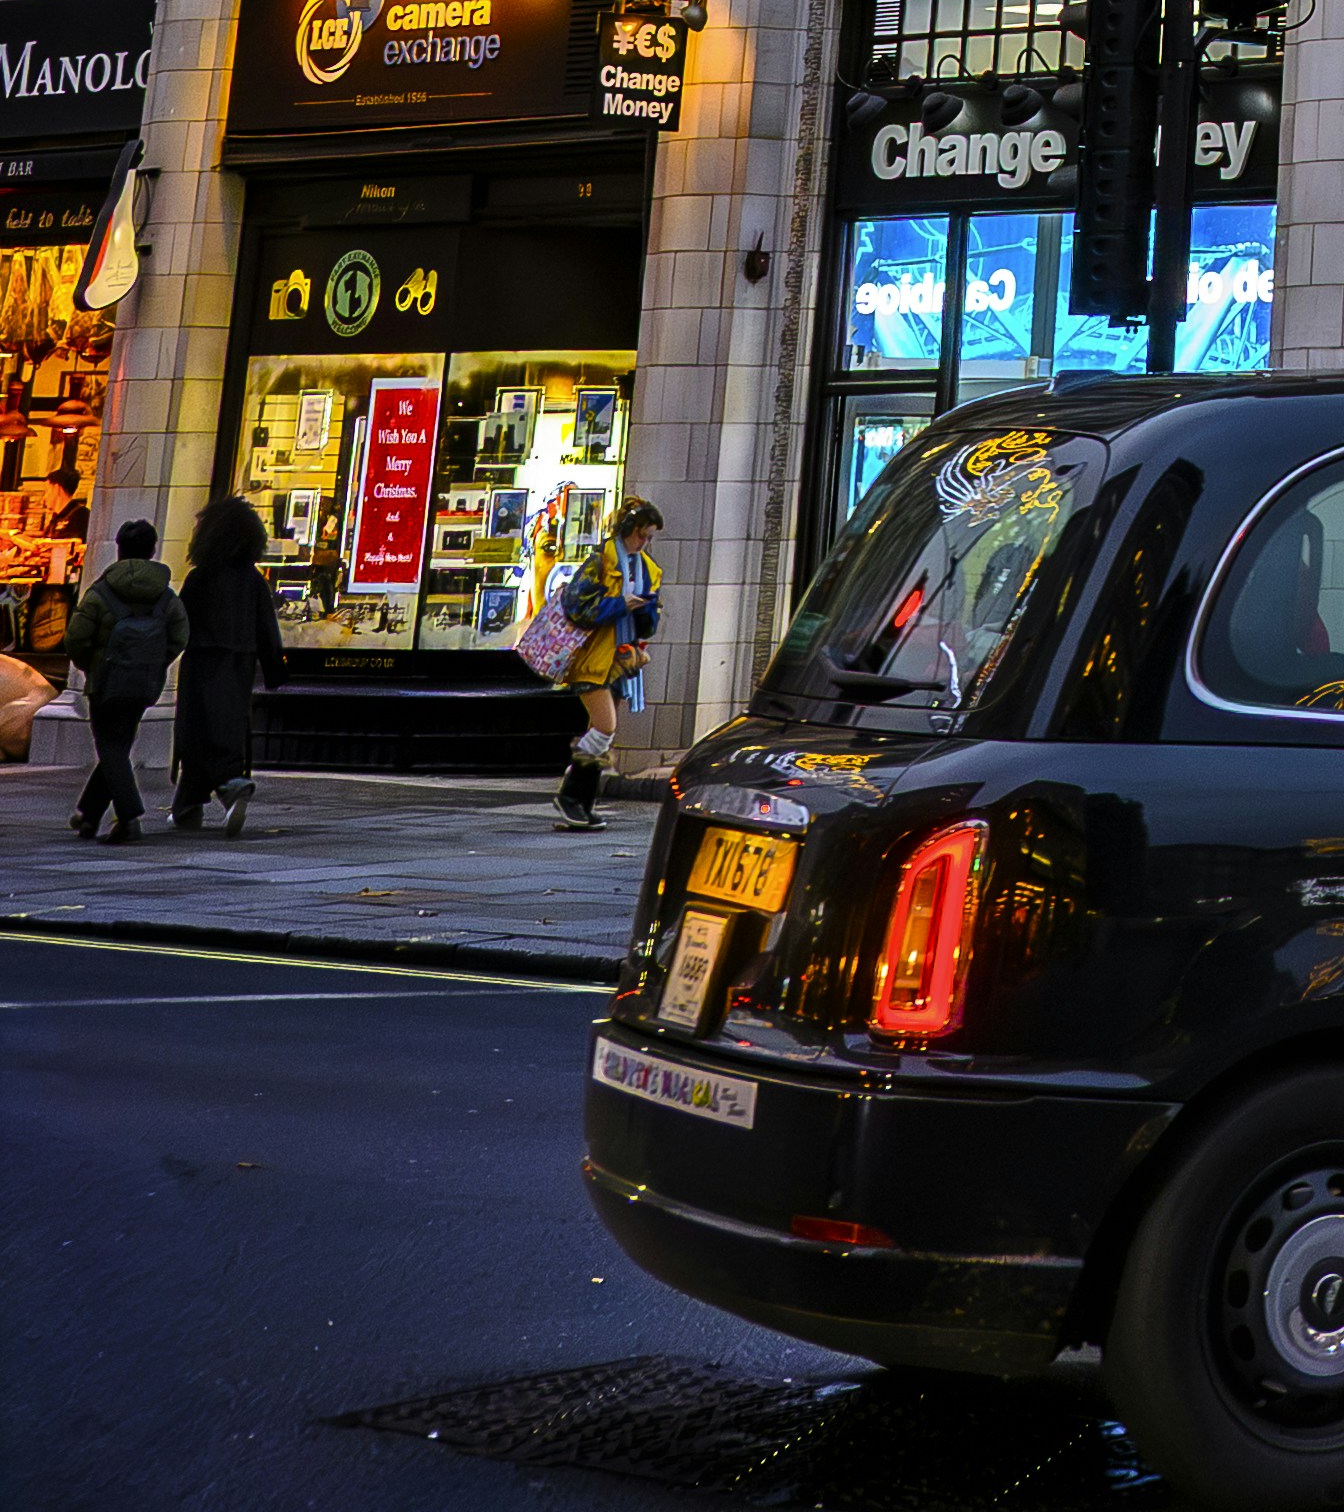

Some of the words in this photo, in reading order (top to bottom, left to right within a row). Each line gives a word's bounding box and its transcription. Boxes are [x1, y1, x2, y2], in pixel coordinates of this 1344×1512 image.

[309, 17, 349, 51] LCE
[383, 31, 501, 69] exchange
[600, 65, 681, 97] Change
[602, 93, 674, 125] Money
[7, 160, 34, 177] BAR
[871, 121, 1067, 190] Change
[361, 184, 396, 199] Nikon
[399, 400, 413, 415] We
[378, 429, 400, 444] Wish
[401, 428, 418, 444] You
[418, 428, 427, 444] A
[386, 455, 413, 476] Merry
